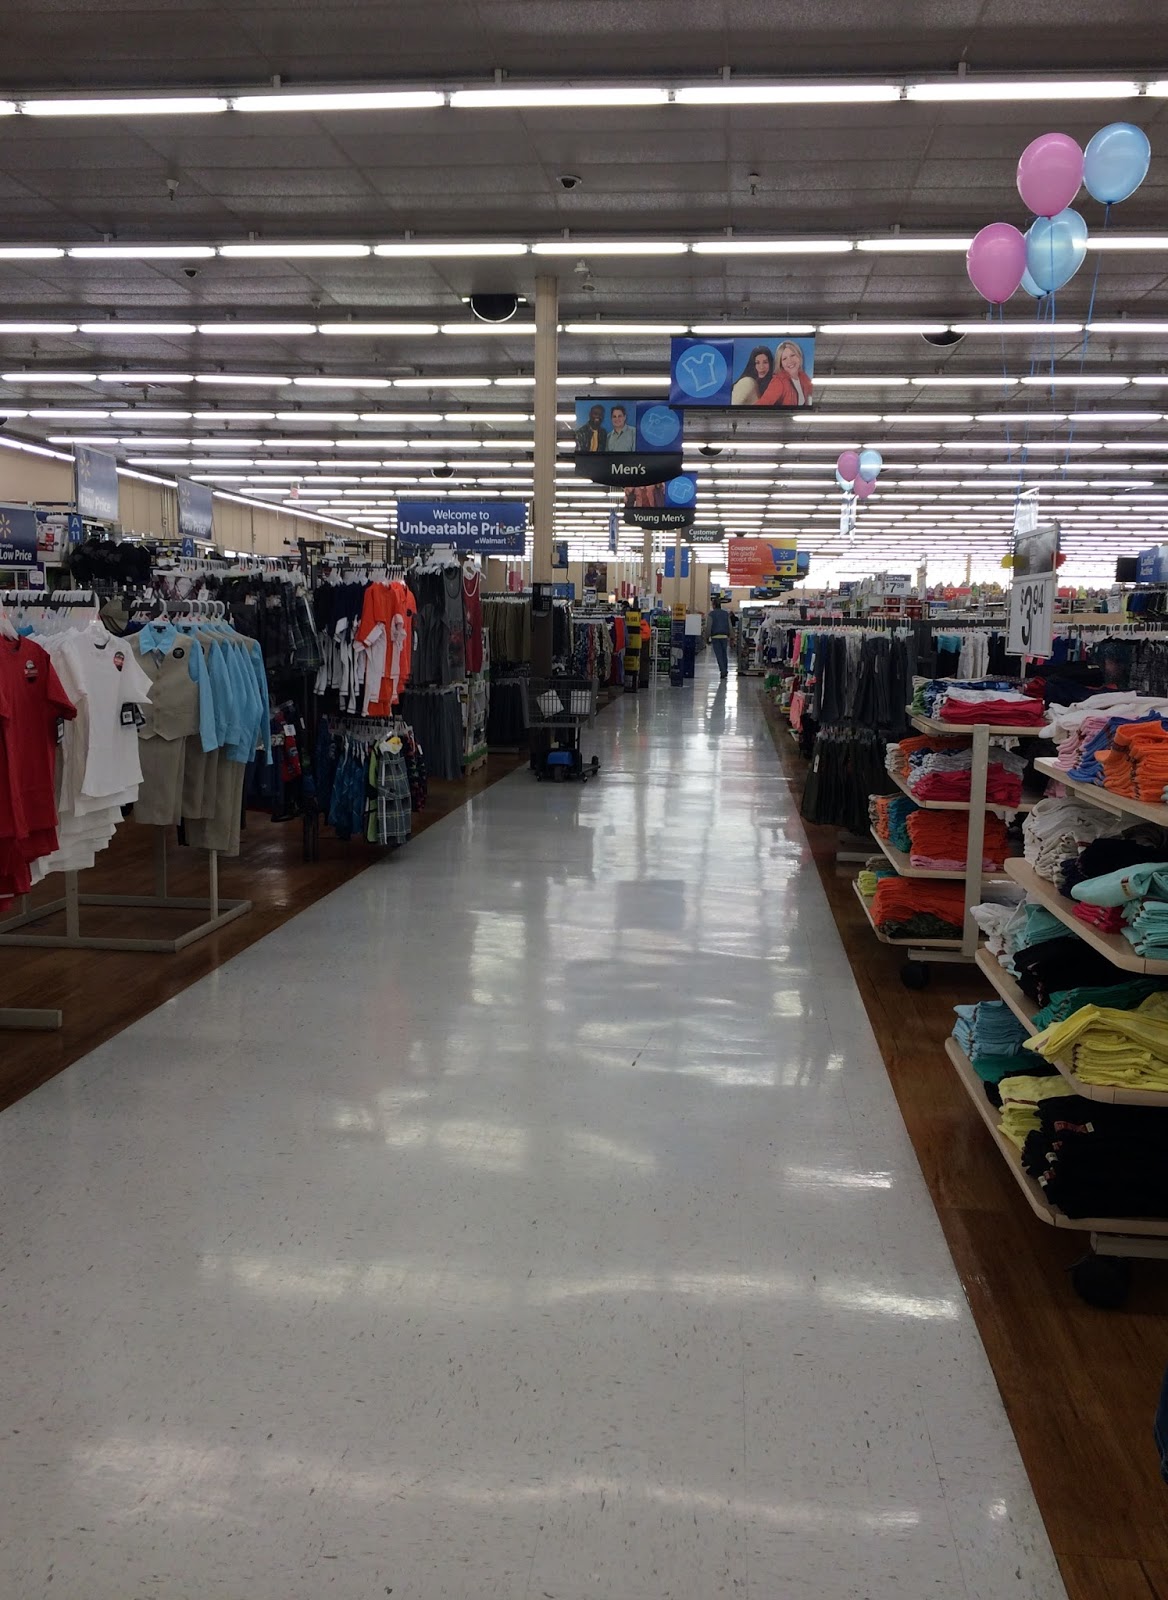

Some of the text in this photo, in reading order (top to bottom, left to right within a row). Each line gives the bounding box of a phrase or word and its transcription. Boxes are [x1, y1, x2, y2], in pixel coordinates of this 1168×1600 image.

[611, 463, 646, 475] Men's
[95, 498, 111, 513] Price
[433, 509, 490, 520] Welcome to
[633, 514, 686, 523] Young Men's
[71, 517, 80, 528] A
[400, 521, 479, 535] Unbeatable
[71, 531, 80, 540] 11
[689, 528, 718, 536] Customer
[184, 540, 192, 548] A
[480, 537, 507, 545] Walmart
[0, 549, 33, 560] Low Price
